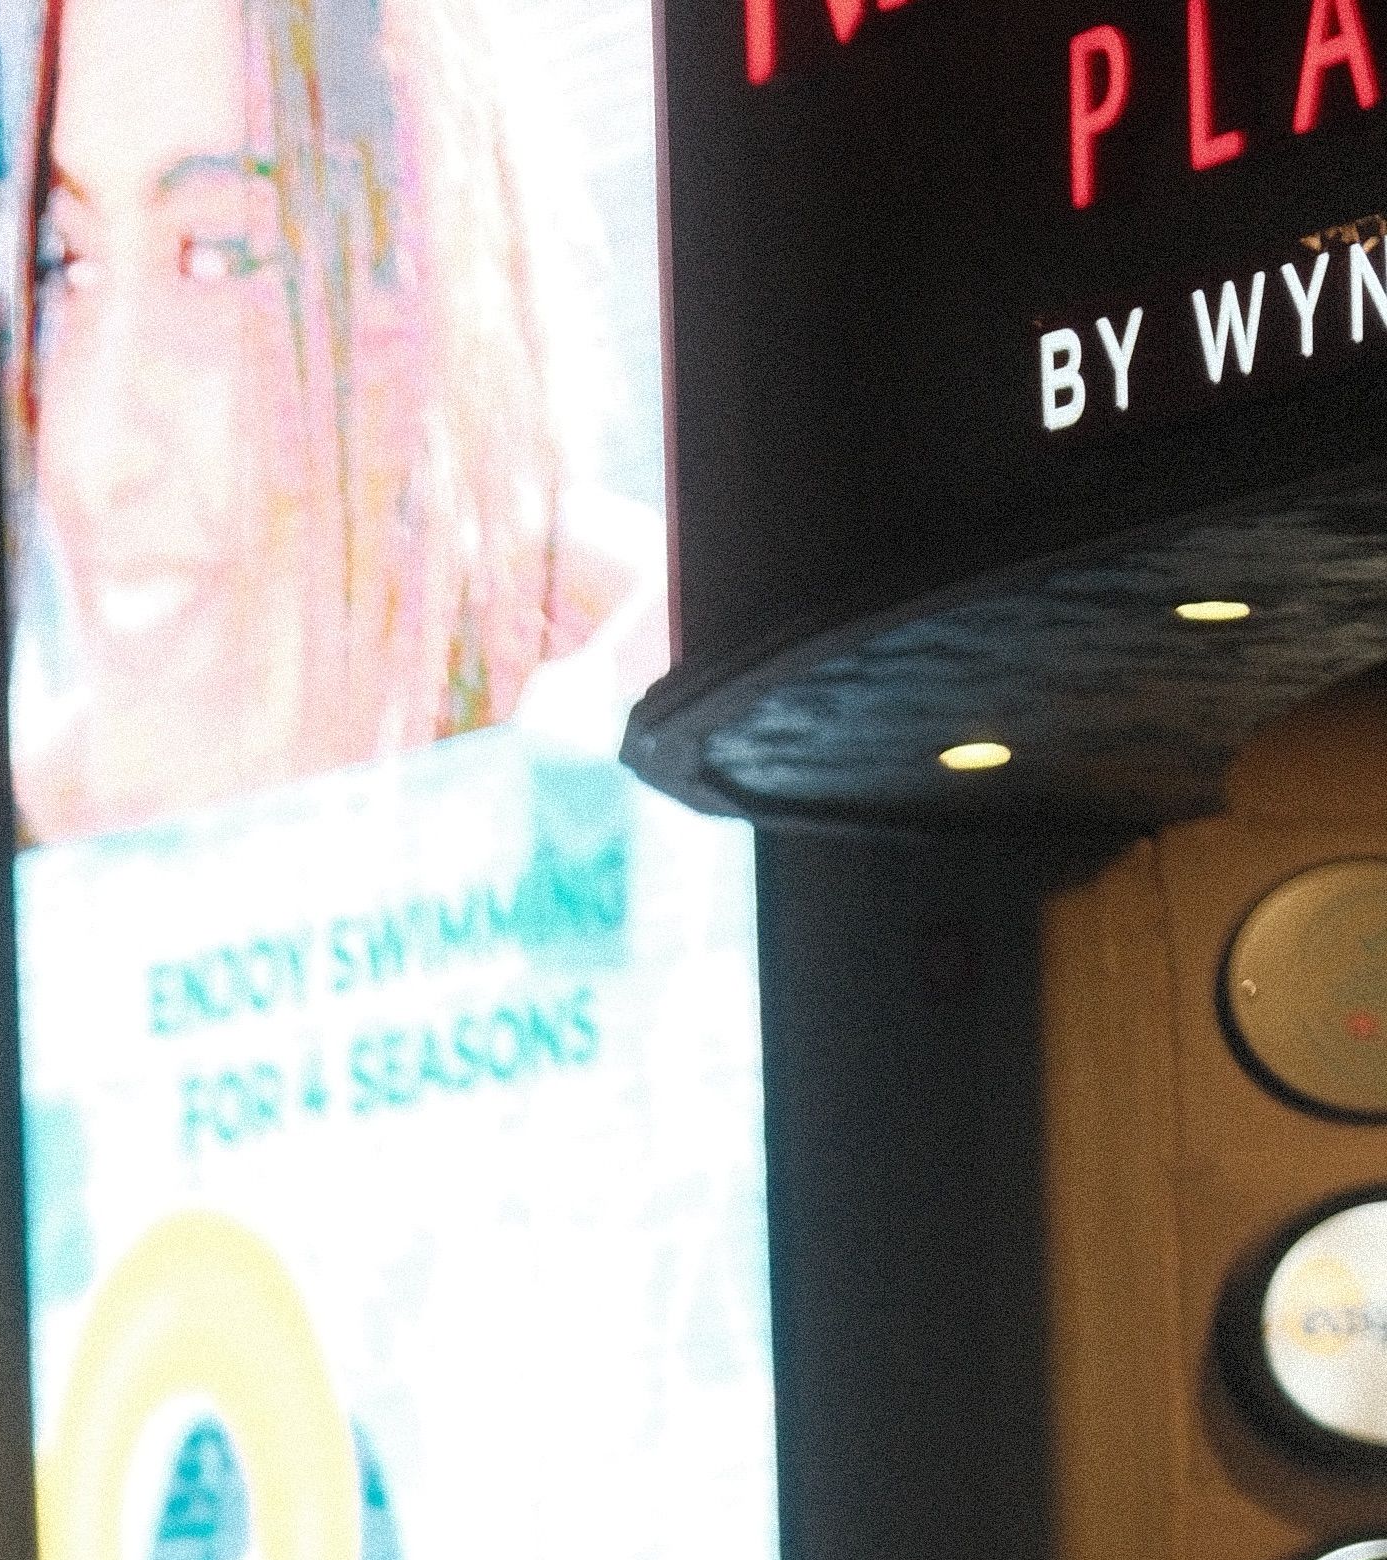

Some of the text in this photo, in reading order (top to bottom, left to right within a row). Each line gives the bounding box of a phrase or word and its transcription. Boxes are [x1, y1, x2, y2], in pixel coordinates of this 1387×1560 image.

[1039, 307, 1144, 431] BY
[145, 836, 629, 1038] ENJOY SWIMMING
[177, 986, 603, 1160] FOR 4 SEASONS
